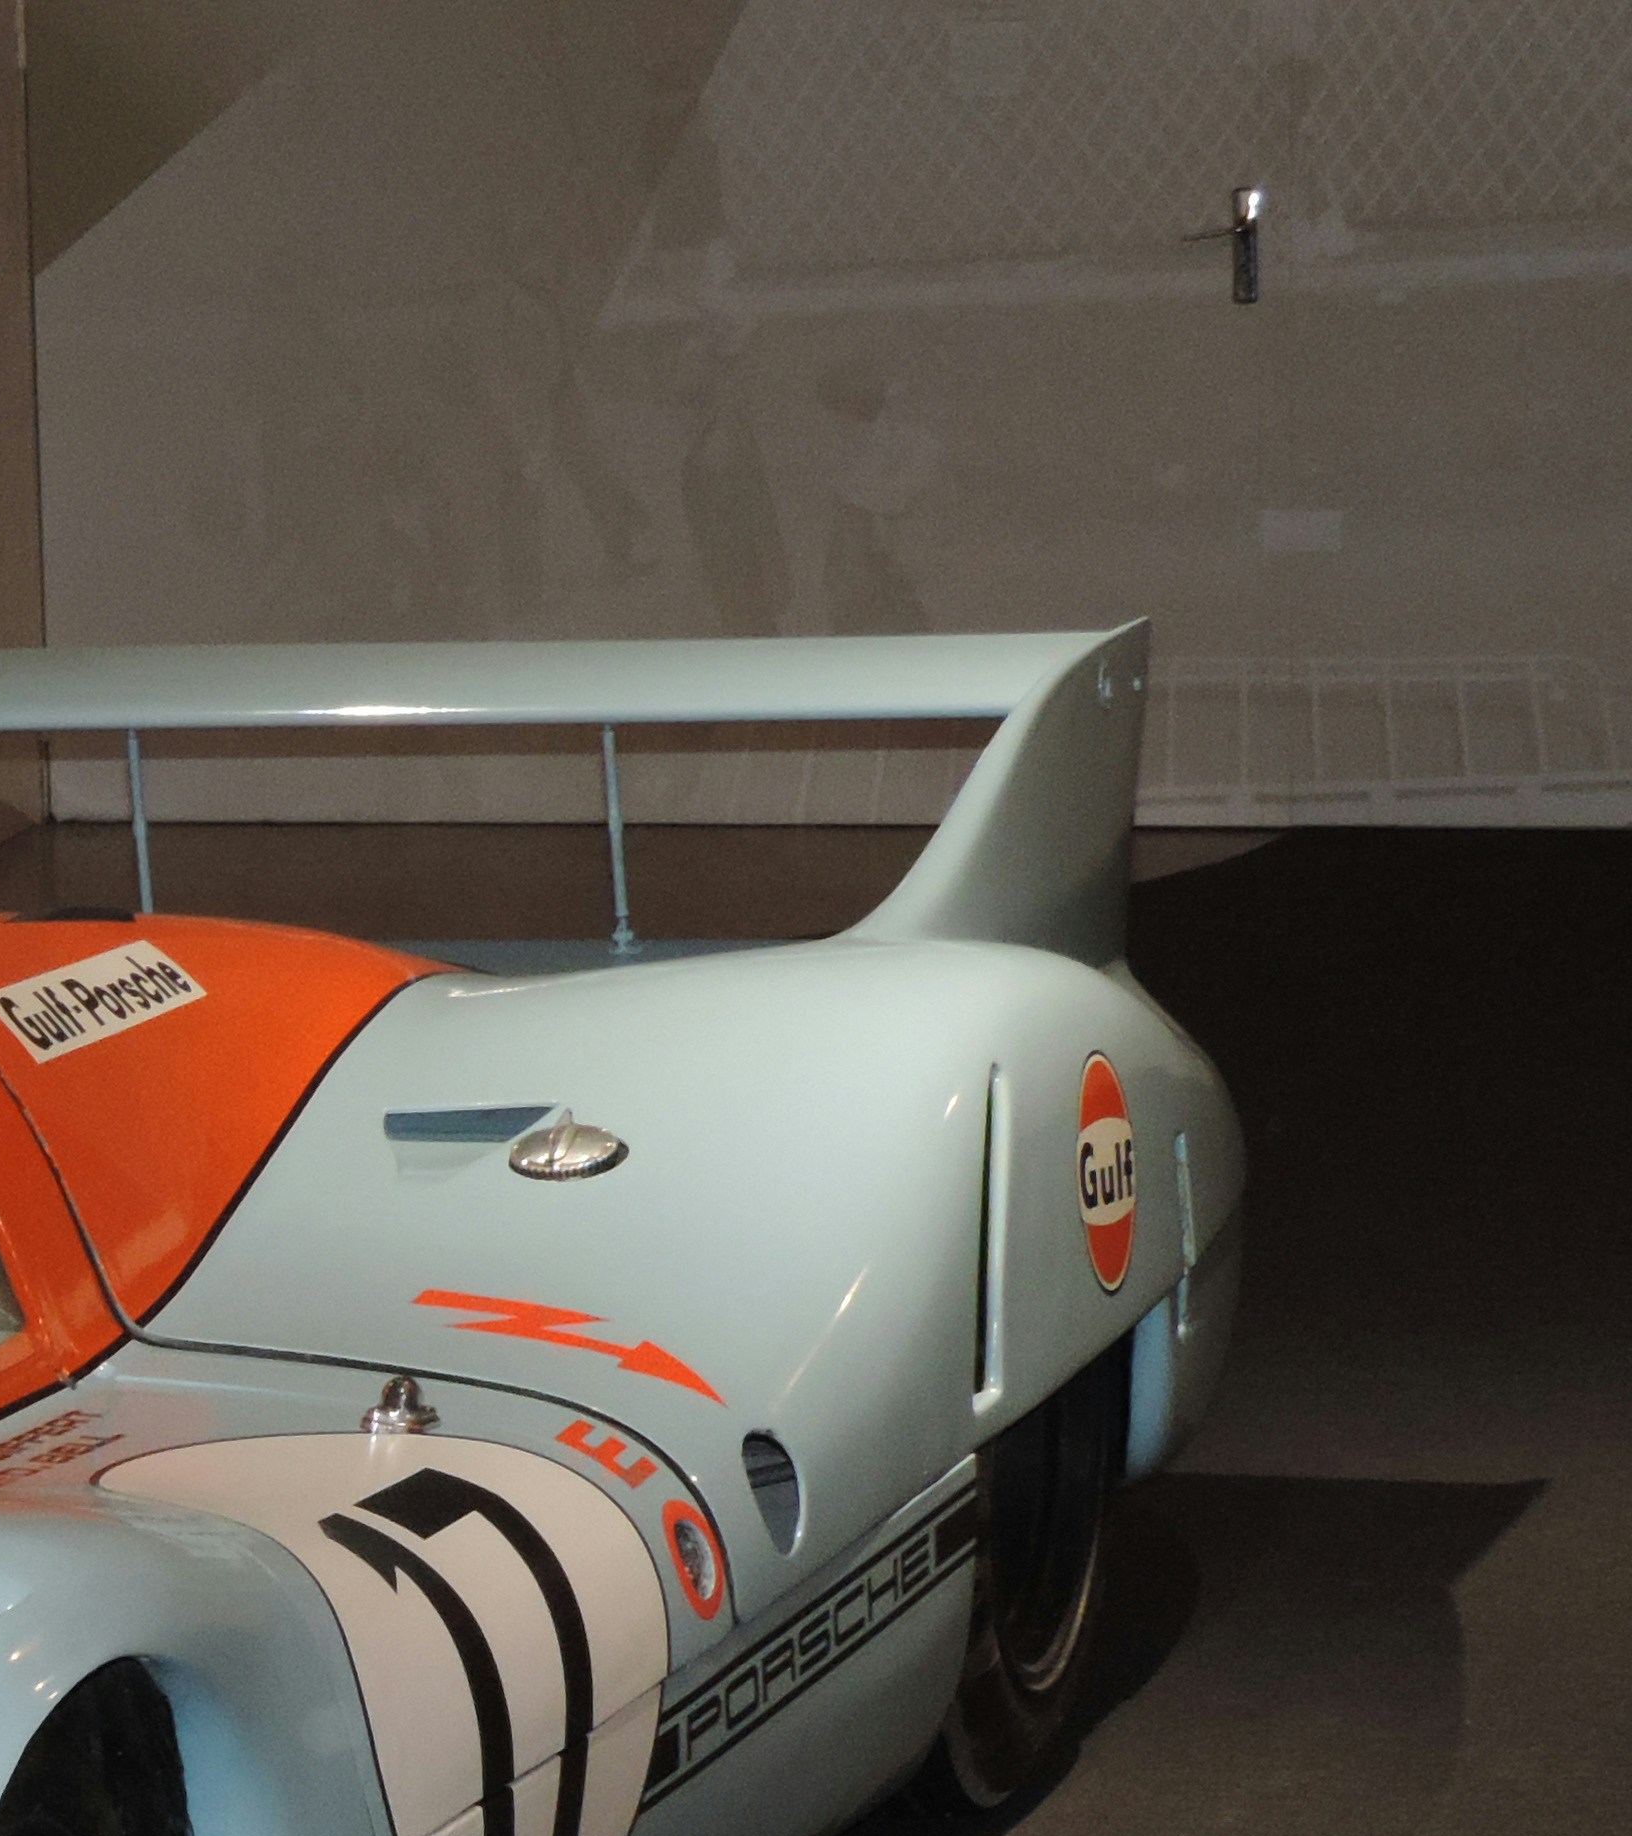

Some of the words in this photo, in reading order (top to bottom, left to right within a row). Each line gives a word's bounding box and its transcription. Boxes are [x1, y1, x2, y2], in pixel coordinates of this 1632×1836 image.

[0, 956, 192, 1050] Gulf-Porsche
[1079, 1138, 1134, 1209] Gulf
[687, 1532, 931, 1762] PORSCHE
